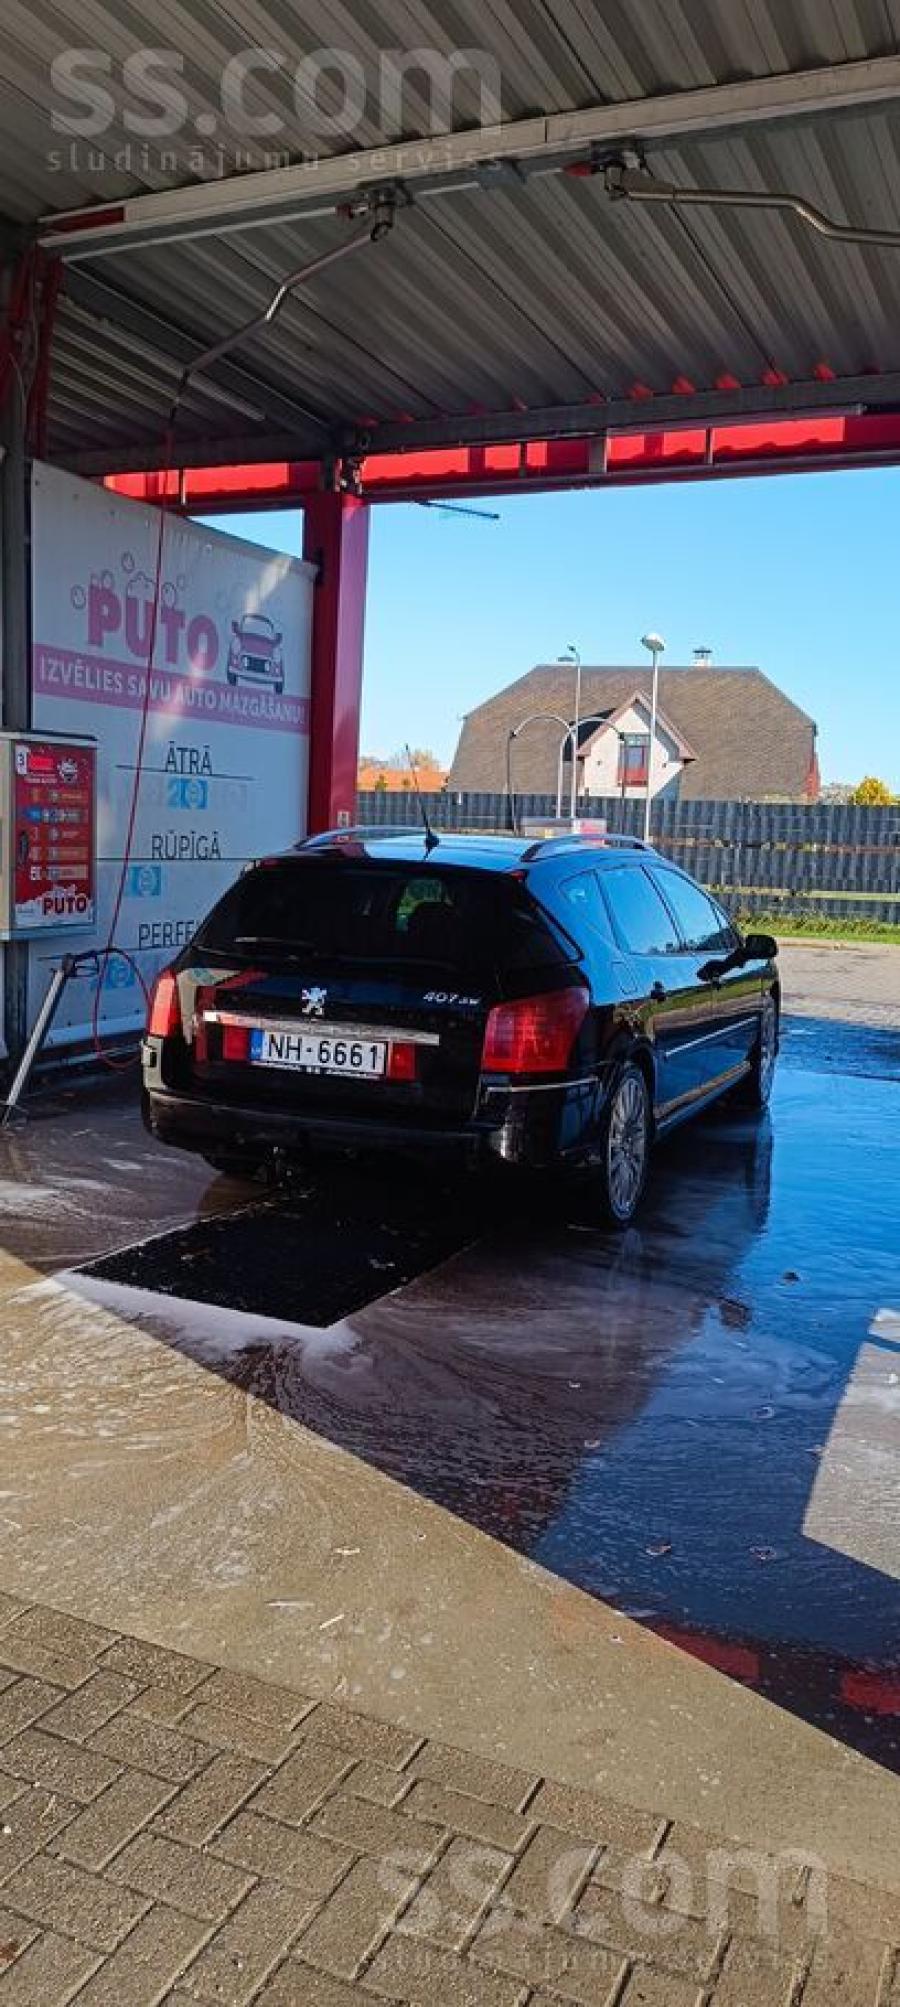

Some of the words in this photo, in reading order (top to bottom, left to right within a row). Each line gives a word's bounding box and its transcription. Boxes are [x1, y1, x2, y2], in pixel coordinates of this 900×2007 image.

[87, 581, 220, 671] PUTO
[39, 655, 124, 694] IZVĒLIES
[127, 675, 171, 702] SAVU
[174, 683, 216, 710] AUTO
[165, 741, 213, 775] ĀTRĀ
[150, 830, 222, 860] RŪPĪGĀ
[43, 895, 88, 916] PUTO
[138, 920, 196, 950] PERFE
[422, 990, 460, 1004] 407
[267, 1033, 379, 1071] NH-6661
